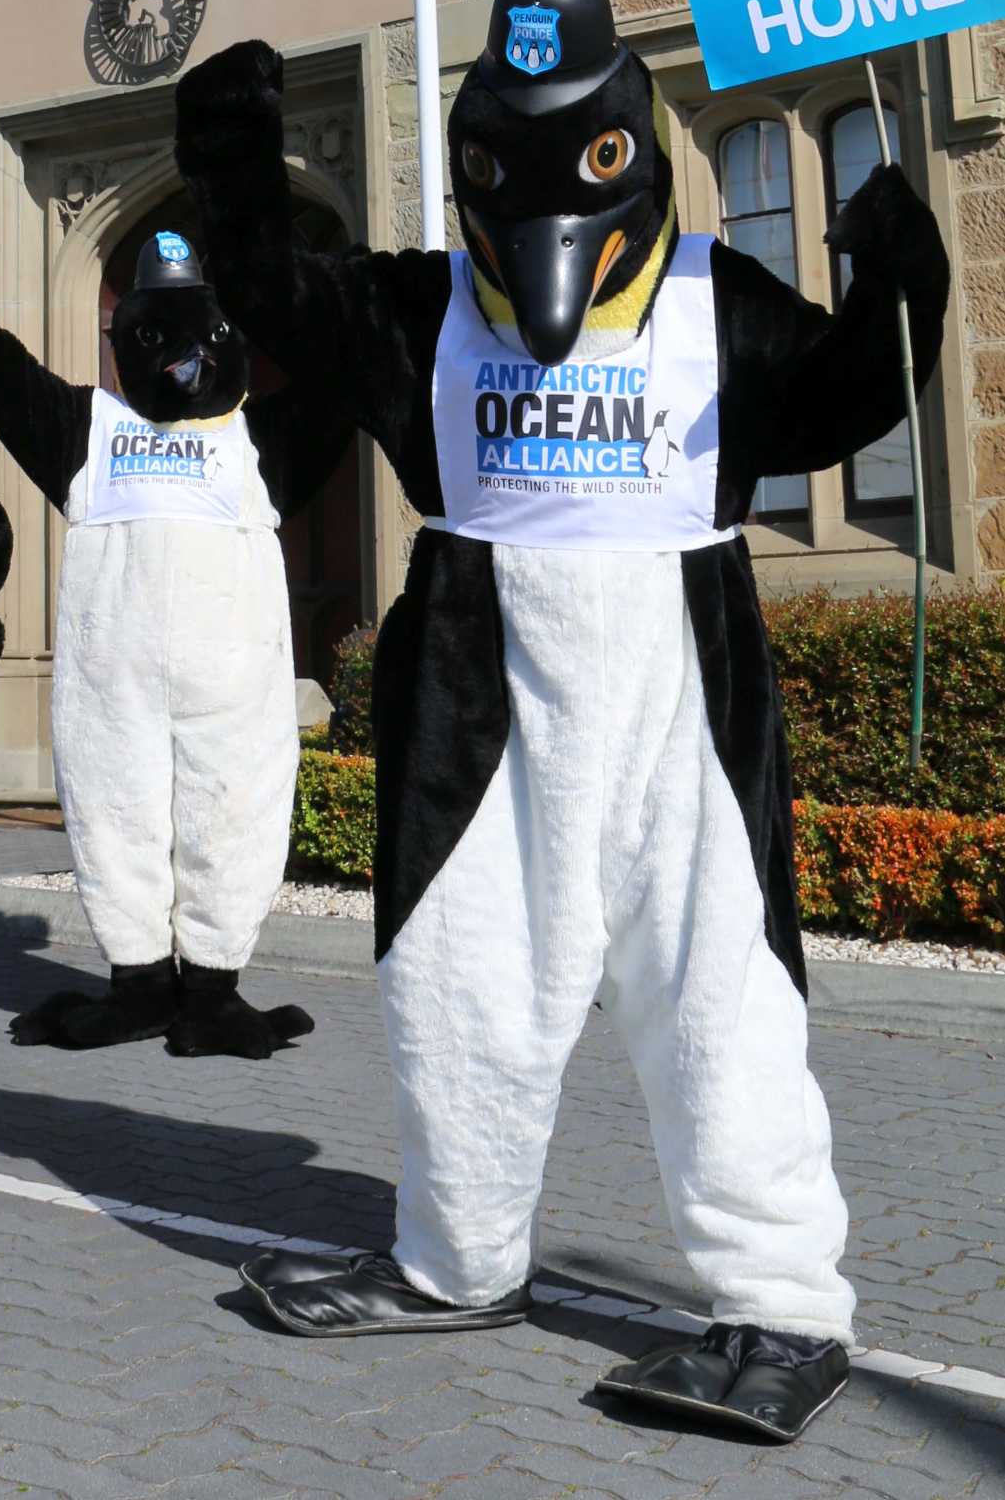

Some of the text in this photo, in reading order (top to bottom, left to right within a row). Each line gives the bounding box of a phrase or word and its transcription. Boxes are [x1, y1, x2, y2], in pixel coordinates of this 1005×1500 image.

[514, 13, 554, 24] PENGUIN
[515, 27, 553, 40] POLICE
[475, 362, 646, 395] ANTARCTIC
[475, 392, 646, 443] OCEAN
[111, 434, 203, 460] OCEAN
[112, 459, 202, 475] ALLIANCE
[482, 444, 640, 473] ALLIANCE
[478, 476, 662, 494] PROTECTING THE WILD SOUTH
